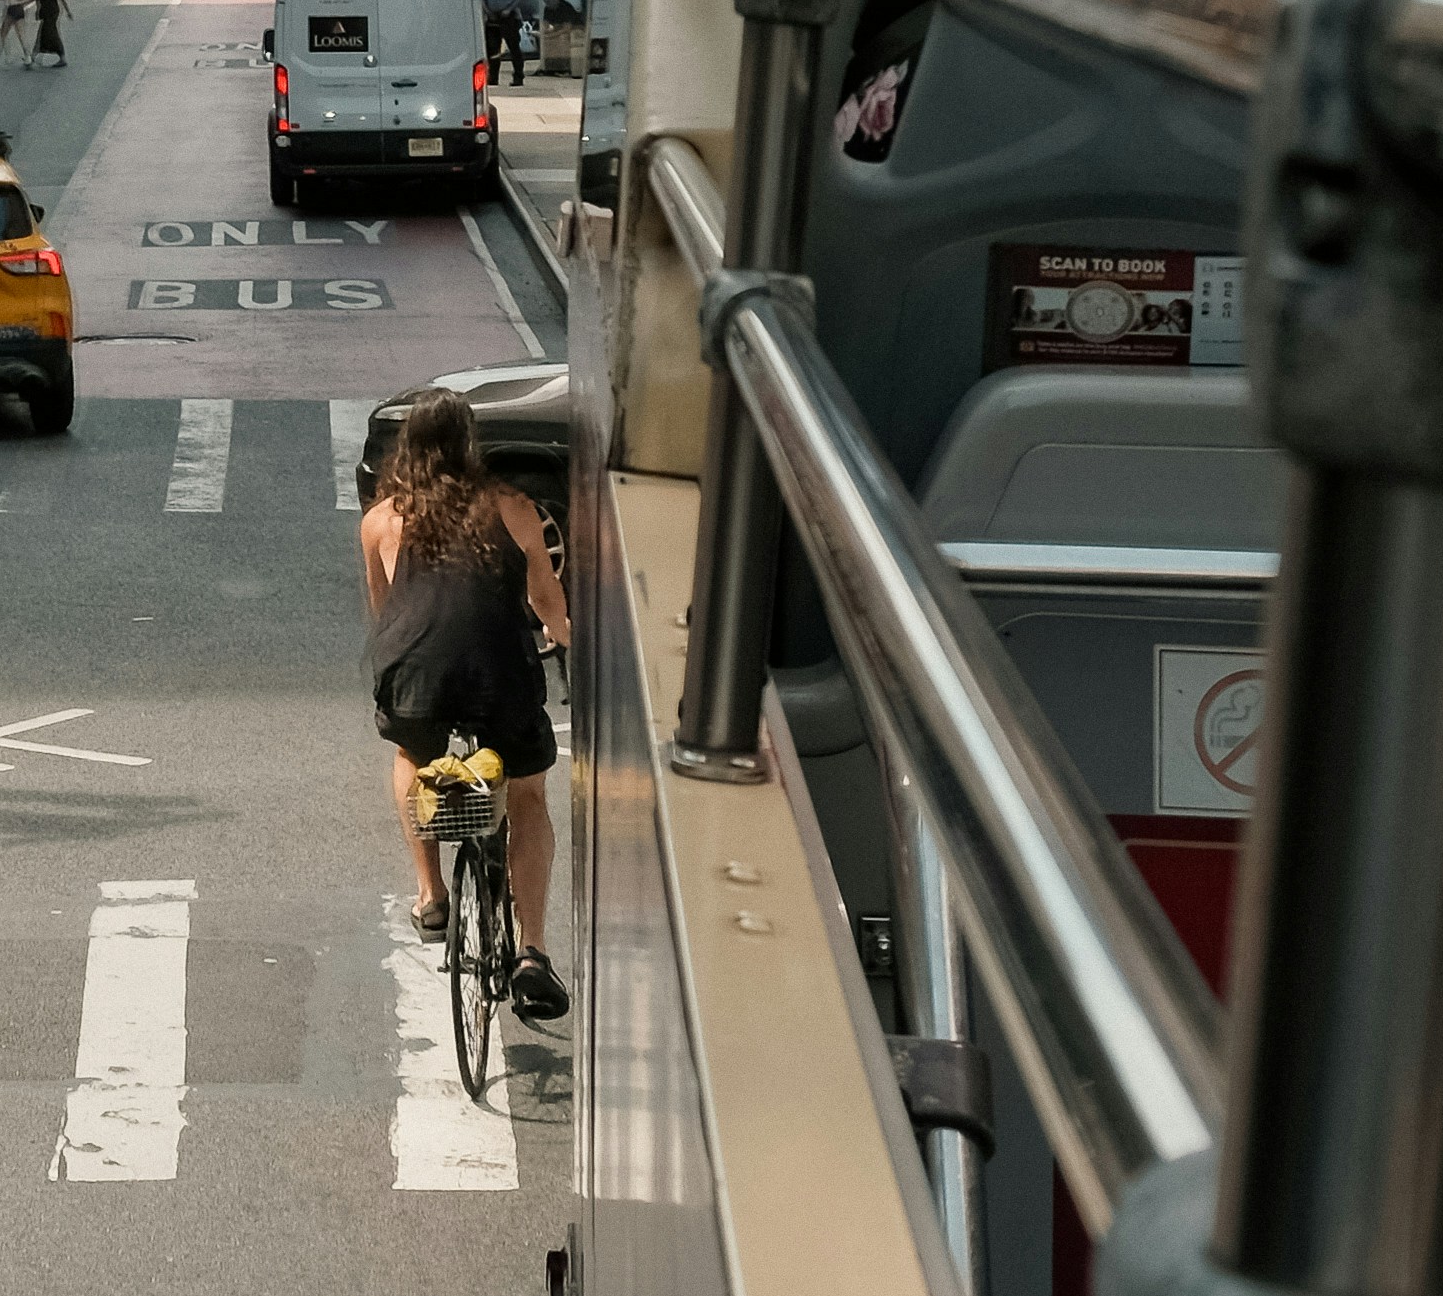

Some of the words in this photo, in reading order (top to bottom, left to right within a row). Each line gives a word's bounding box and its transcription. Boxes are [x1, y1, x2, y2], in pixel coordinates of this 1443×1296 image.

[314, 35, 364, 47] LOOMIS
[146, 220, 389, 246] ONLY
[1039, 256, 1087, 270] SCAN
[1091, 259, 1114, 272] TO
[1117, 259, 1167, 273] BOOK
[136, 278, 384, 309] BUS
